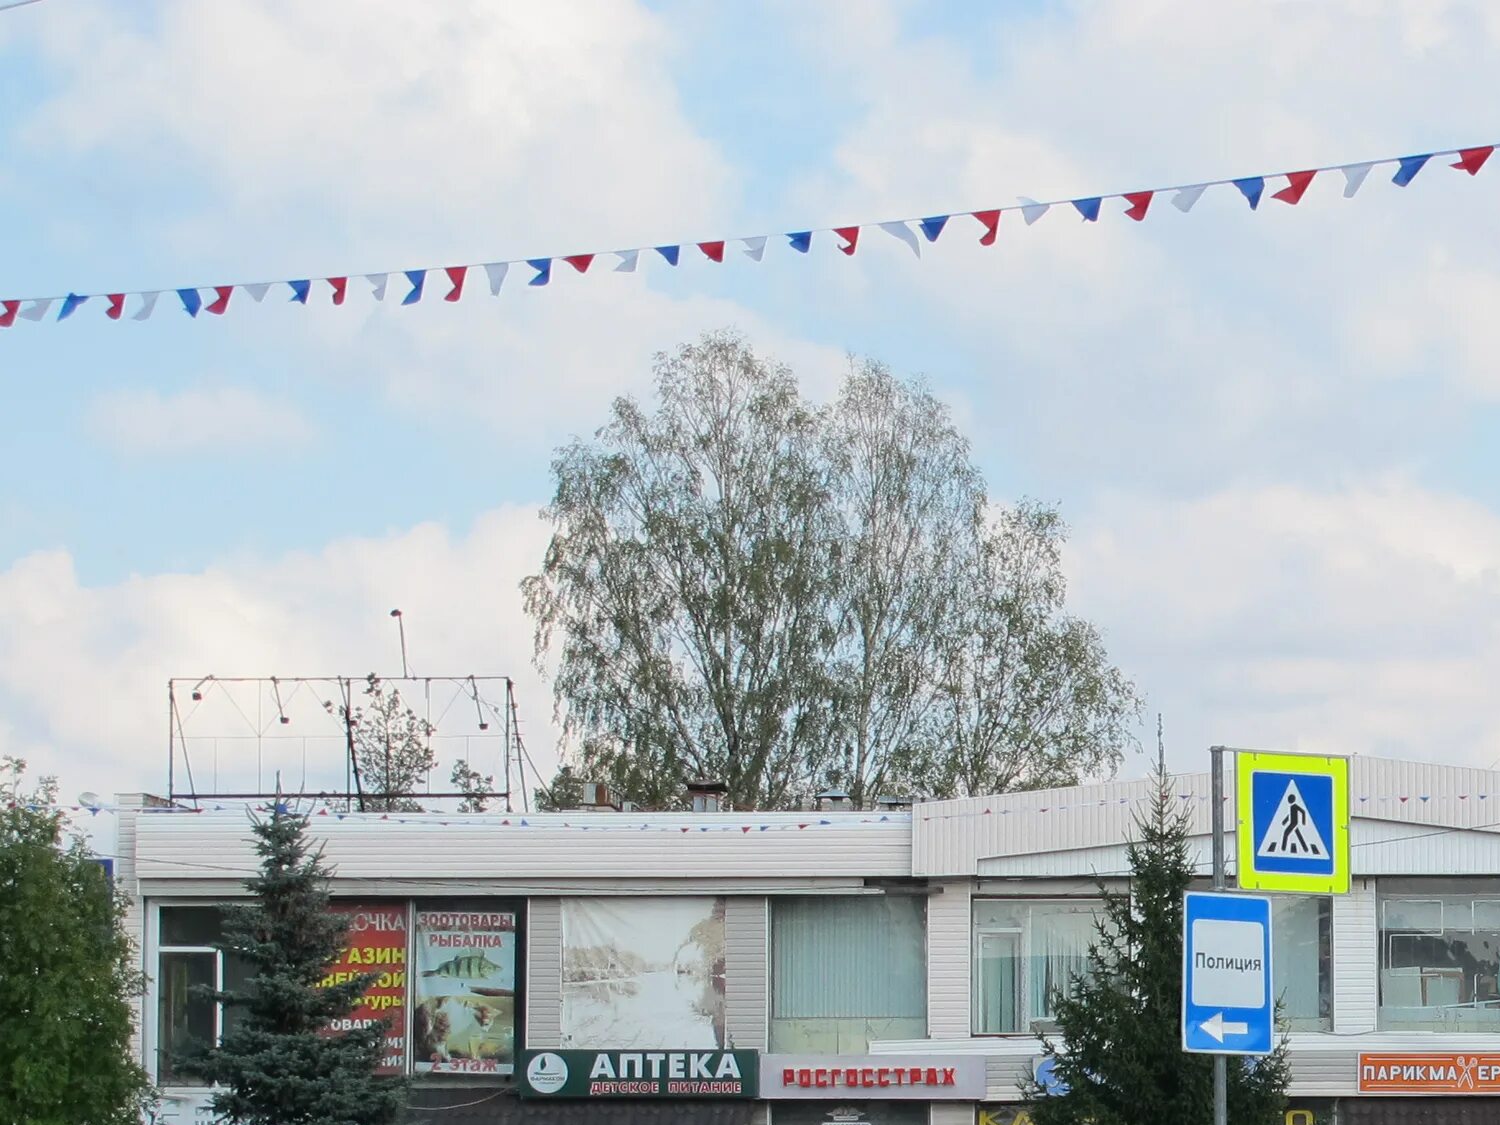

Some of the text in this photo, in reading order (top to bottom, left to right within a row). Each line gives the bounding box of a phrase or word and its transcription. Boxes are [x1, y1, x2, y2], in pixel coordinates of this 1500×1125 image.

[419, 912, 513, 927] ЗООТОВАРЫ
[429, 934, 503, 948] РЫБАЛКА
[1195, 952, 1262, 972] Полиция
[430, 1053, 499, 1072] 2 этаж
[589, 1053, 743, 1079] АПТЕКА
[783, 1068, 957, 1088] РОСГОССТРАХ
[590, 1081, 743, 1096] ДЕТСКОЕ ПИТАНИЕ
